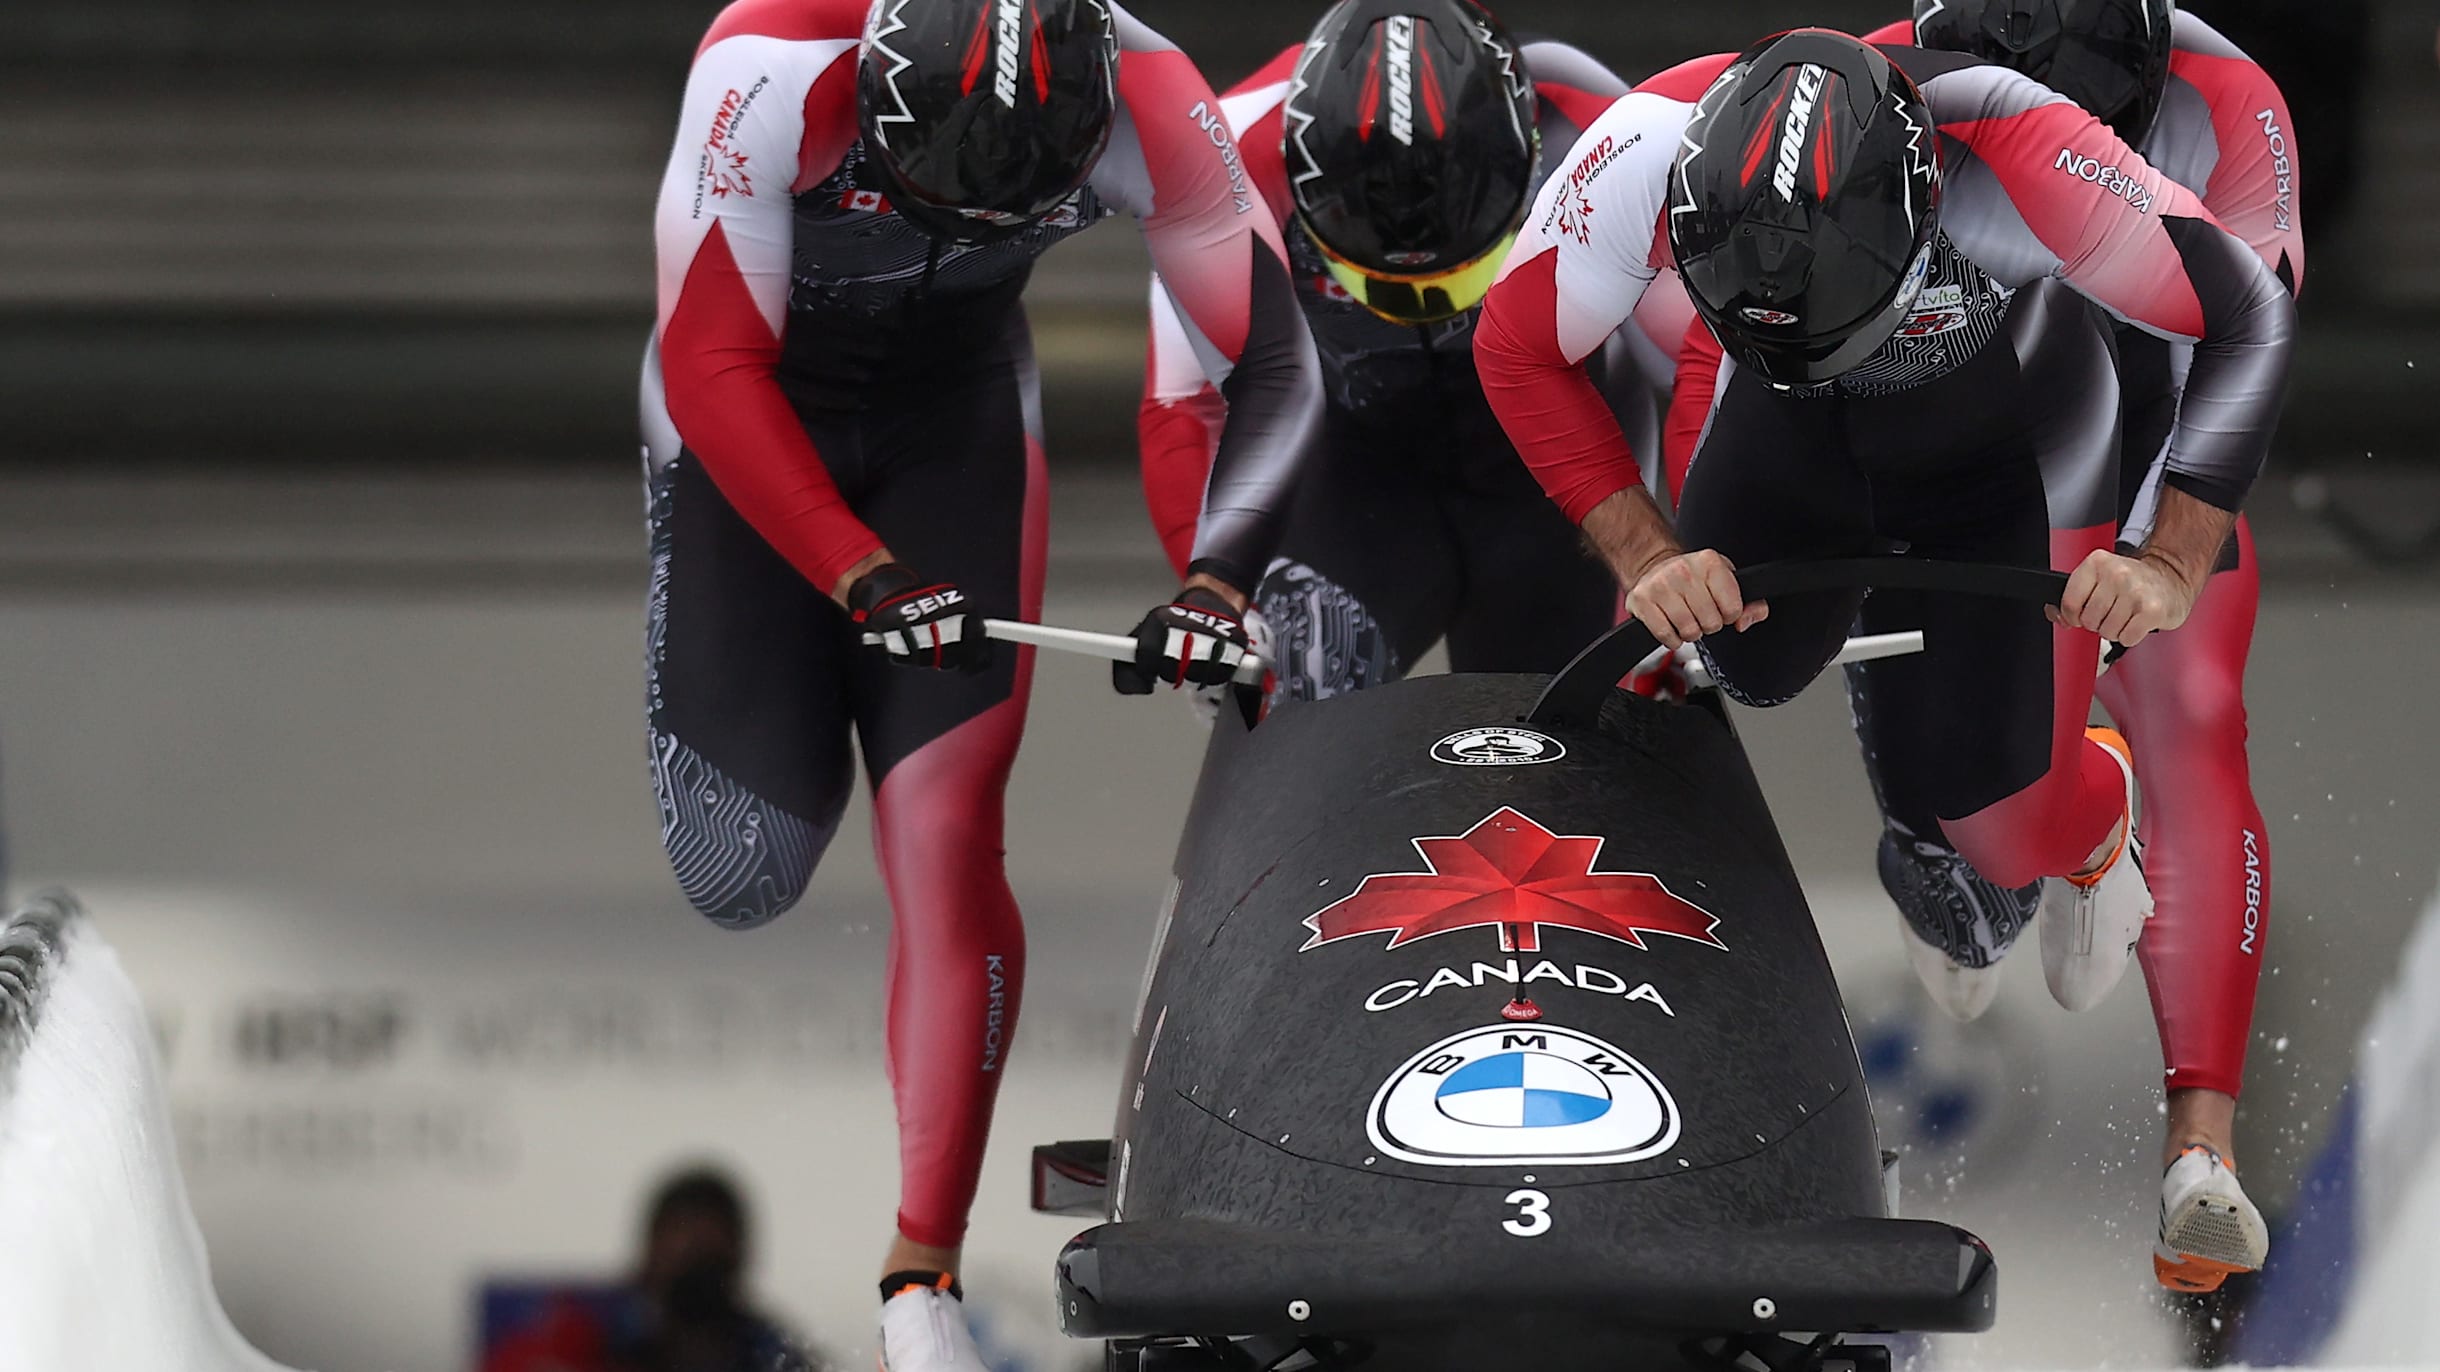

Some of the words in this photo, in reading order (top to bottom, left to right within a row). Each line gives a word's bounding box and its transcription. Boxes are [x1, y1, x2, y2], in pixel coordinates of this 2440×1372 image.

[995, 0, 1024, 109] ROCK
[708, 88, 741, 150] CANADA
[1188, 100, 1253, 214] KARBON
[1571, 135, 1612, 188] CANADA
[1585, 133, 1642, 186] BOBSLEIGH
[2054, 147, 2153, 213] KARBON
[2255, 108, 2290, 231] KARBON
[900, 589, 964, 622] SEIZ
[2240, 828, 2261, 955] KARBON
[983, 955, 1004, 1071] KARBON
[1364, 959, 1675, 1017] CANADA
[1501, 1189, 1552, 1237] 3
